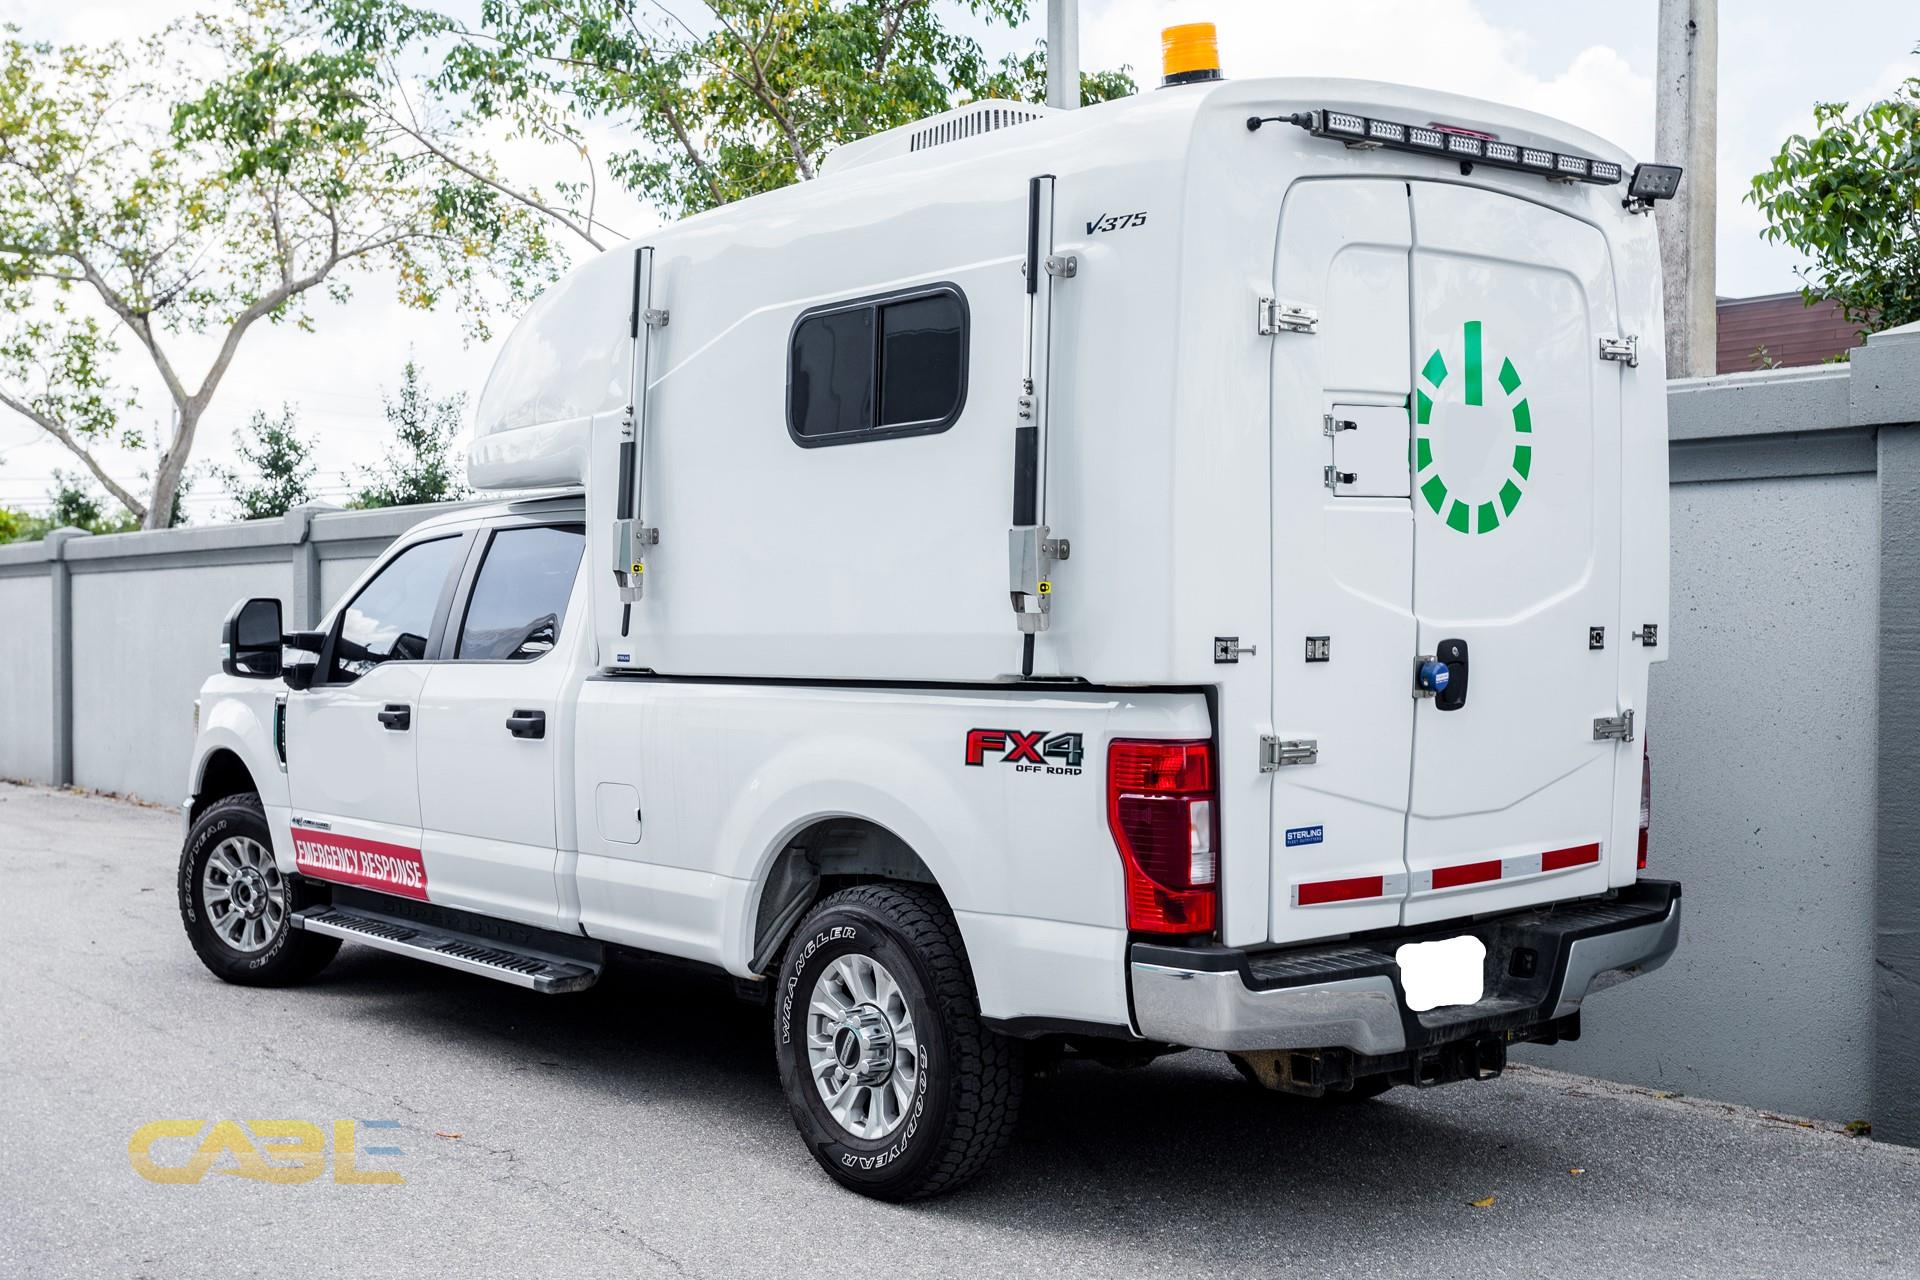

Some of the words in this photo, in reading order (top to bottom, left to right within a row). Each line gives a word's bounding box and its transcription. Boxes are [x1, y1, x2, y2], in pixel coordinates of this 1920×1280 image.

[965, 728, 1084, 767] FX4
[1015, 764, 1042, 773] OFF
[1046, 766, 1083, 776] ROAD
[1287, 829, 1322, 840] STERLING
[296, 840, 358, 874] EMERGENCY
[360, 851, 423, 888] RESPONSE
[782, 926, 857, 1044] WRANGLER
[842, 1045, 928, 1170] GOODYEAR
